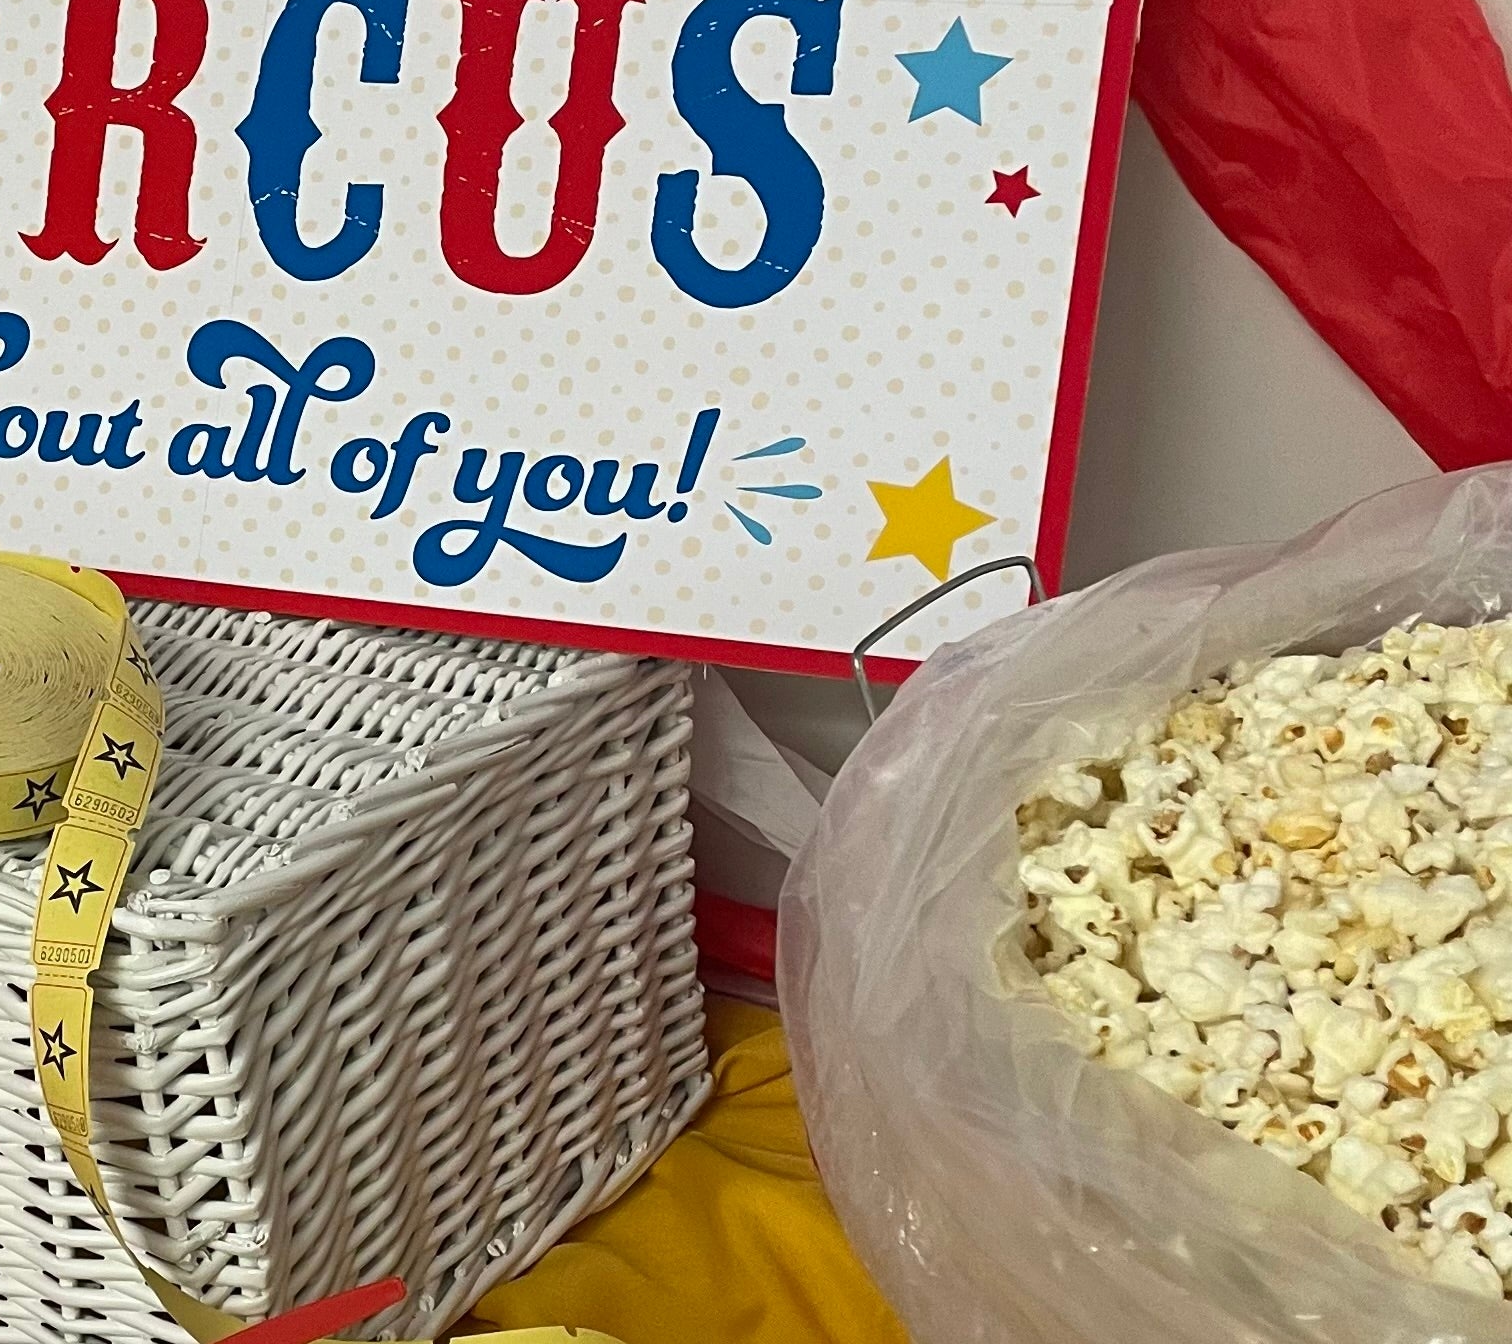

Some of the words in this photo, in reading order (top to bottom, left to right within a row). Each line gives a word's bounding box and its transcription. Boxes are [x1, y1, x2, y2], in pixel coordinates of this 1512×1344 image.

[167, 318, 376, 485] all
[329, 409, 453, 522] of
[411, 406, 722, 587] you!
[74, 793, 135, 823] 6290502
[40, 945, 91, 964] 6290501
